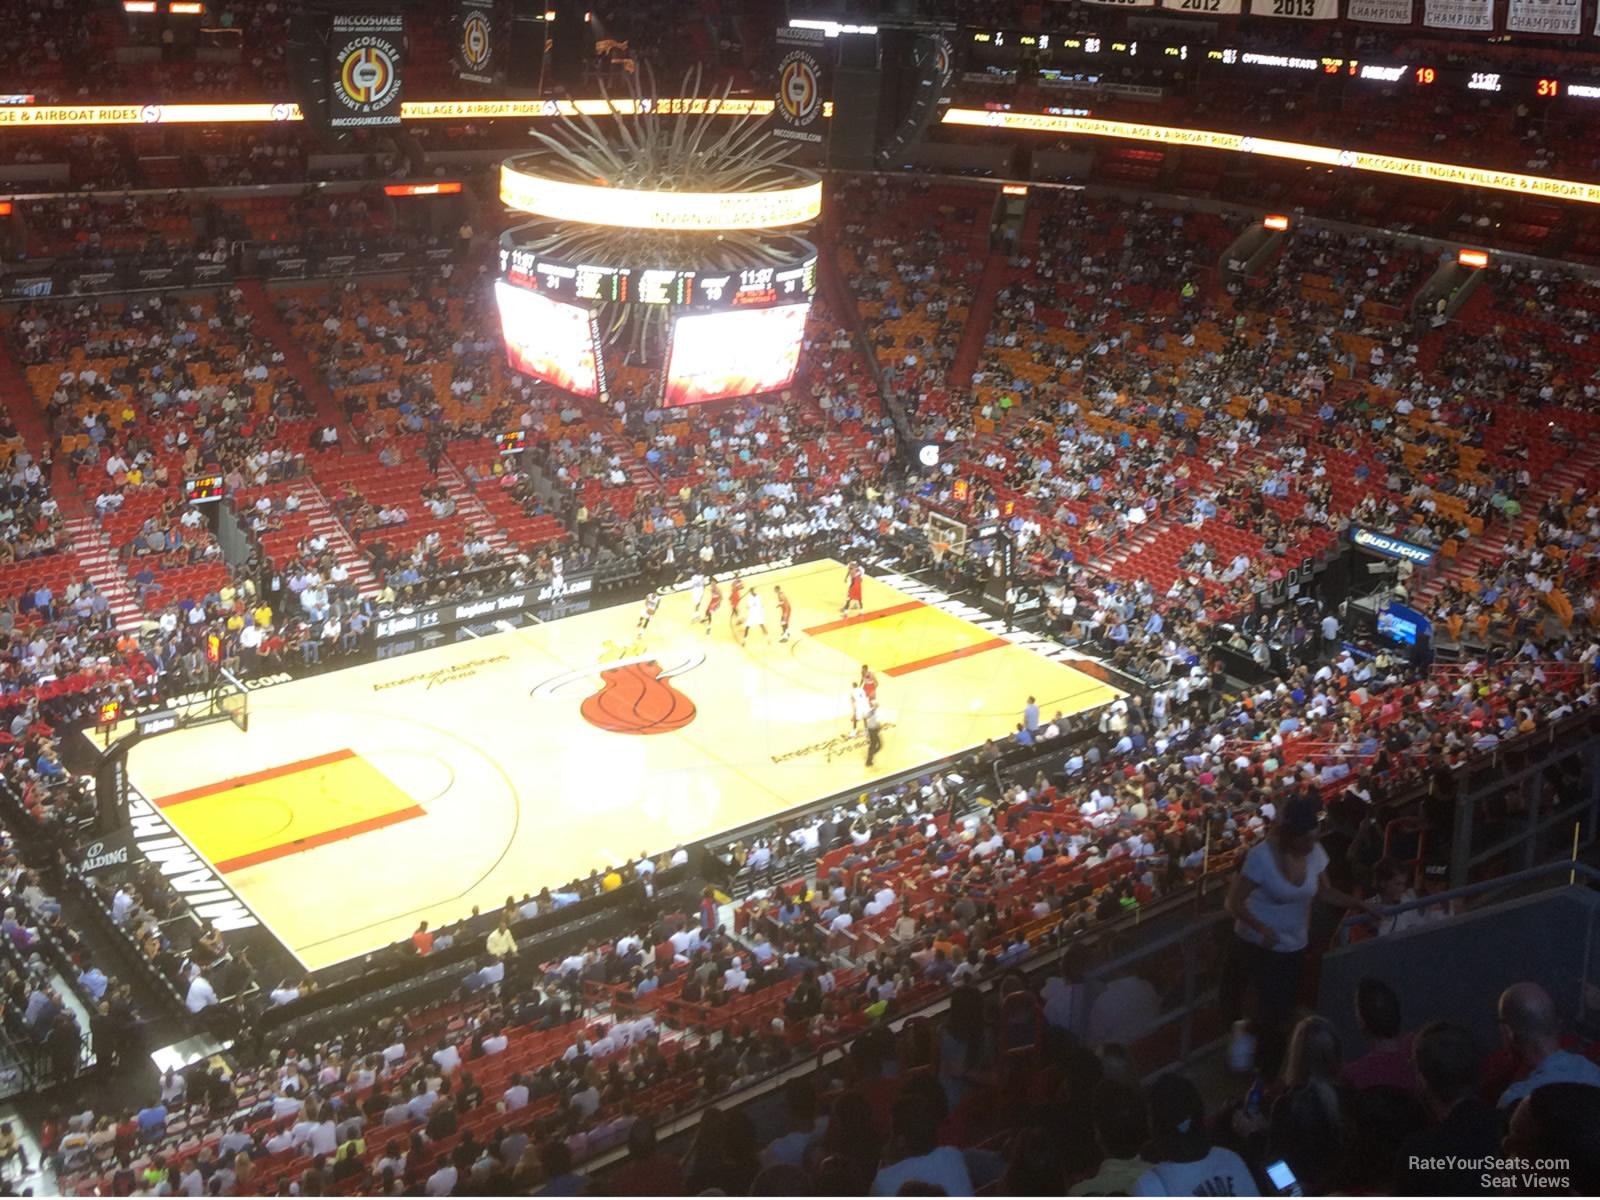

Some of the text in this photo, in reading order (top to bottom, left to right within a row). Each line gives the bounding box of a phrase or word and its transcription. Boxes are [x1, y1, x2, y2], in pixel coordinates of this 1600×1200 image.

[1273, 0, 1314, 16] 2013
[1351, 6, 1408, 19] CHAMPIONS
[334, 15, 402, 25] MICCOSUKEE
[1427, 11, 1488, 25] CHAMPIONS
[1510, 16, 1577, 29] CHAMPIONS
[337, 36, 400, 62] MICCOSUKEE
[1289, 57, 1318, 70] STATS
[1416, 68, 1435, 83] 19
[1537, 80, 1558, 96] 31
[21, 111, 30, 121] &
[35, 110, 95, 121] AIRBOAT
[100, 109, 137, 119] RIDES
[411, 105, 452, 115] VILLAGE
[467, 104, 511, 113] AIRBOAT
[513, 103, 540, 113] RIDES
[332, 116, 402, 127] MICCOSUKEE.COM
[1111, 125, 1151, 136] VILLAGE
[1164, 130, 1208, 142] AIRBOAT
[1356, 156, 1422, 174] MICCOSUKEE
[1426, 166, 1466, 179] INDIAN
[1469, 173, 1515, 187] VILLAGE
[1520, 179, 1527, 188] &
[1531, 181, 1584, 195] AIRBOAT
[1360, 532, 1431, 560] BUD LIGHT
[80, 847, 128, 873] ALDING
